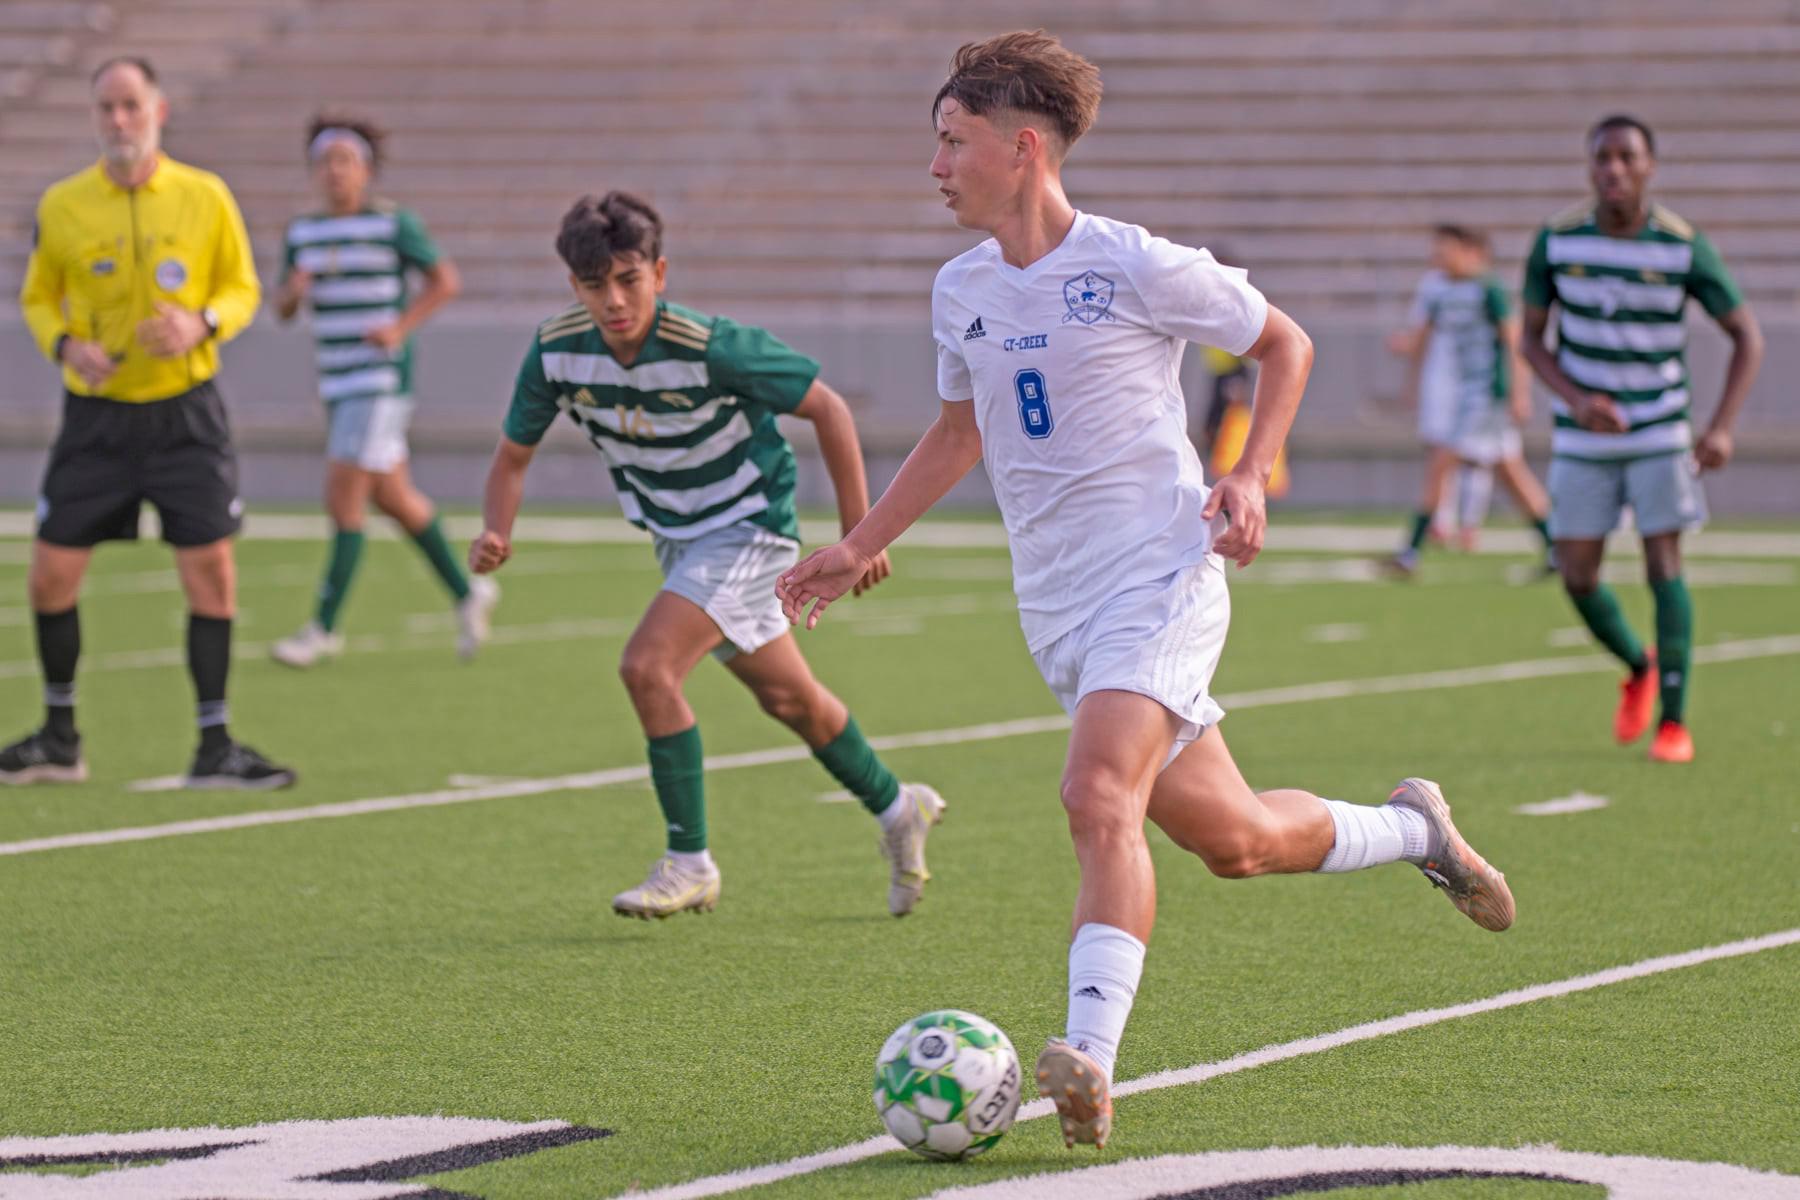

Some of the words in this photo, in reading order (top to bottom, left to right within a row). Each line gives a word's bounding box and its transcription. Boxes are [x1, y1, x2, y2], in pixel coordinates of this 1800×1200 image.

[963, 330, 987, 341] adidas
[1003, 334, 1048, 352] CY-CREEK
[1013, 368, 1055, 440] 8
